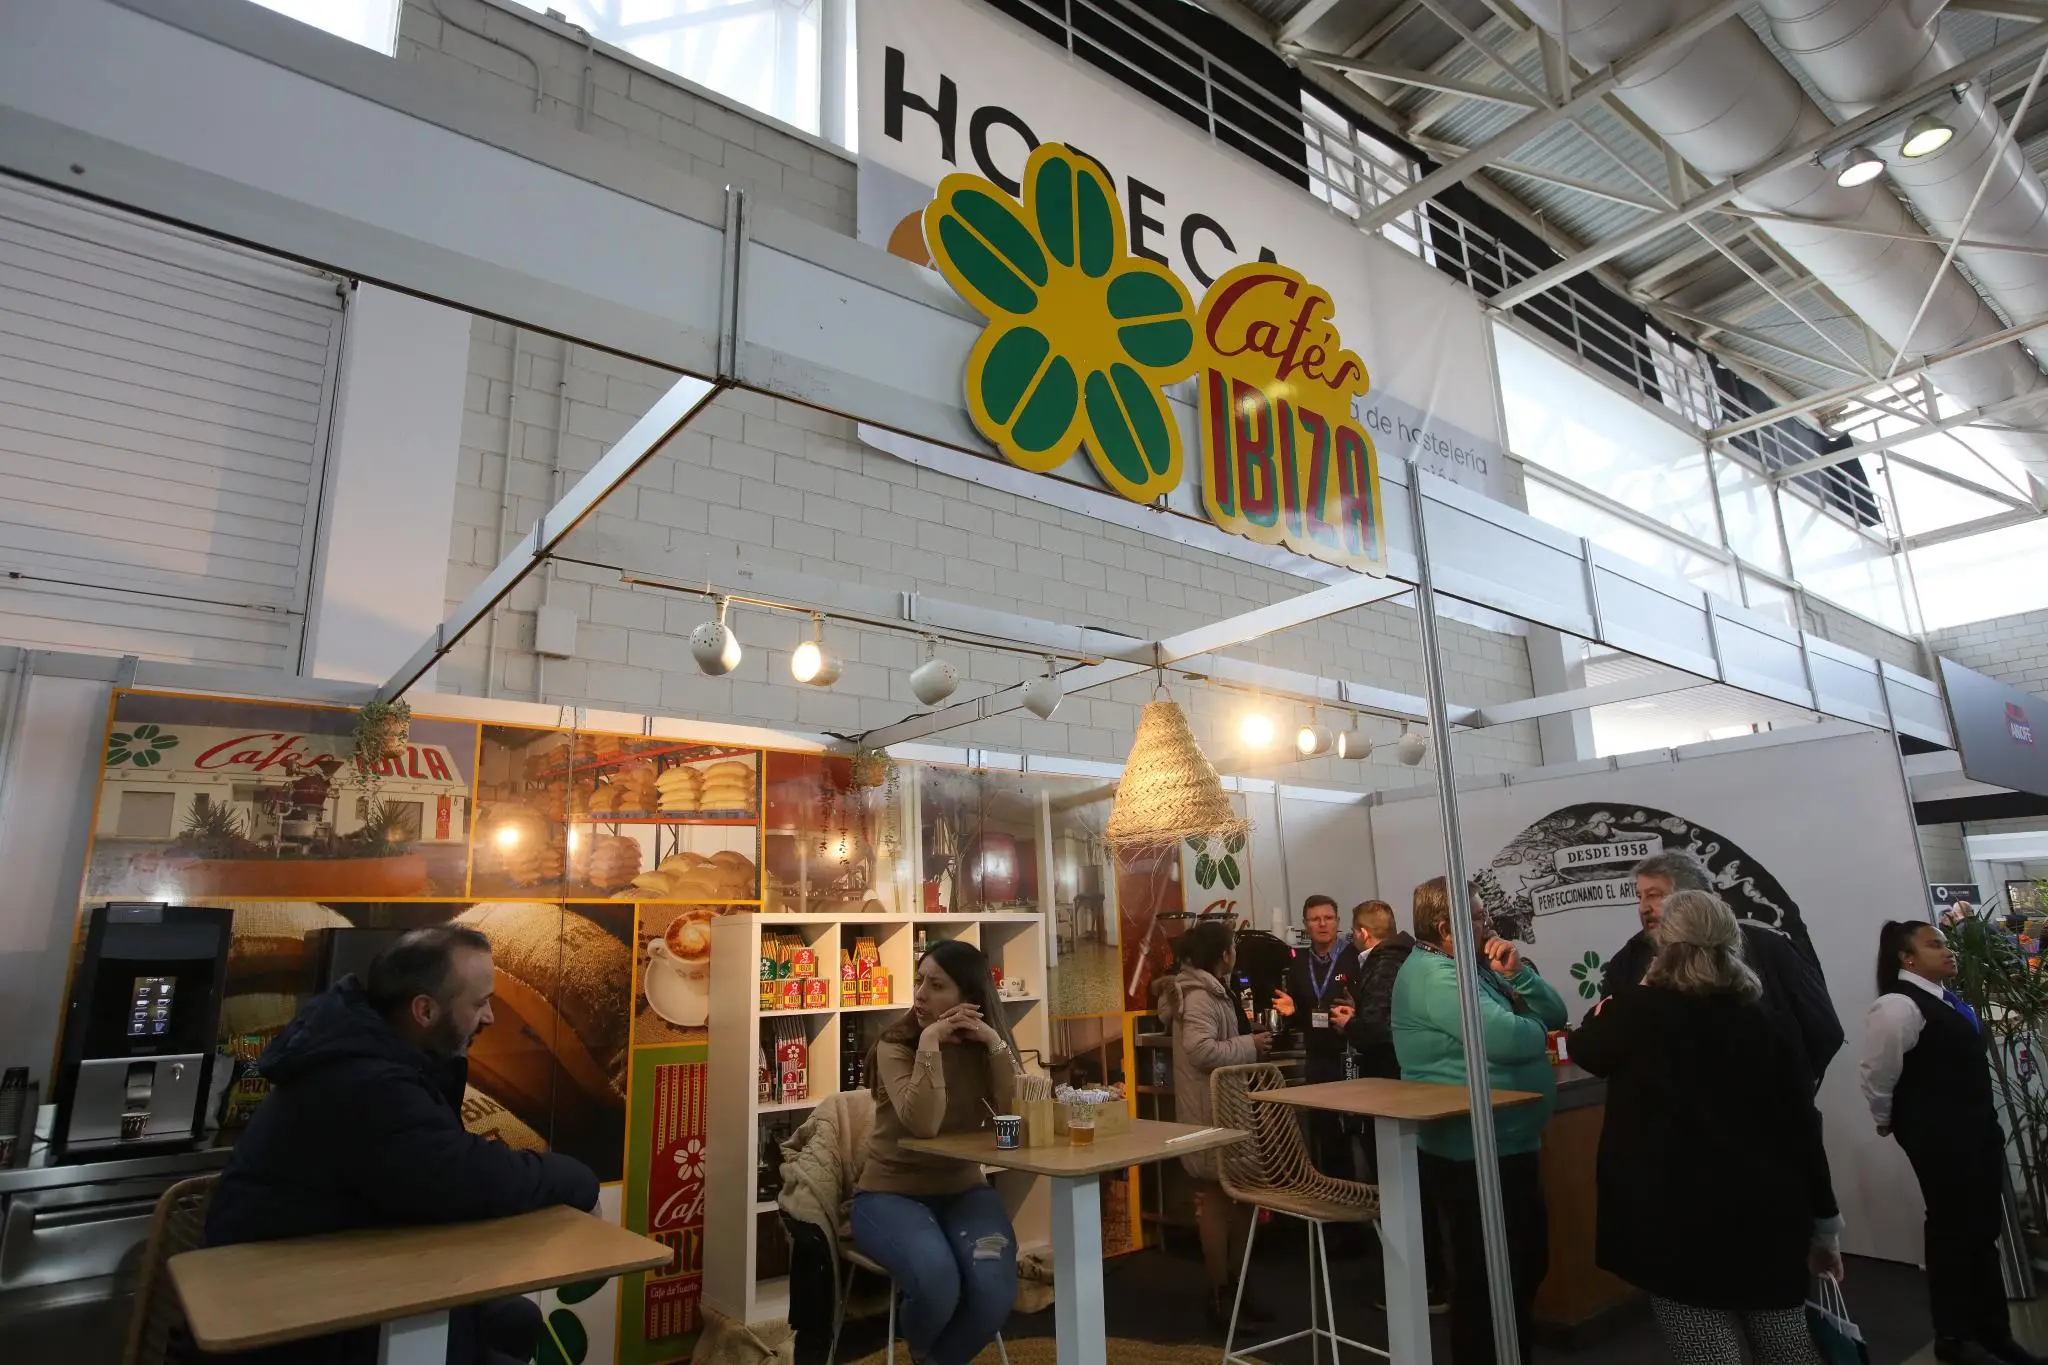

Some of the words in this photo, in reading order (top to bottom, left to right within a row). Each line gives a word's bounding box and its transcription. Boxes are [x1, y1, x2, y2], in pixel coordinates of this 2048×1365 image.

[884, 45, 1278, 289] HOEC
[1205, 274, 1361, 389] Cafés
[1207, 367, 1380, 561] IBIZA
[1366, 406, 1392, 435] de
[1398, 416, 1488, 476] hostelería
[1567, 846, 1611, 864] DESDE
[1614, 842, 1649, 857] 1958
[1538, 884, 1603, 912] PERFECCIONANDO
[1605, 884, 1616, 900] EL
[654, 1181, 706, 1229] Caf
